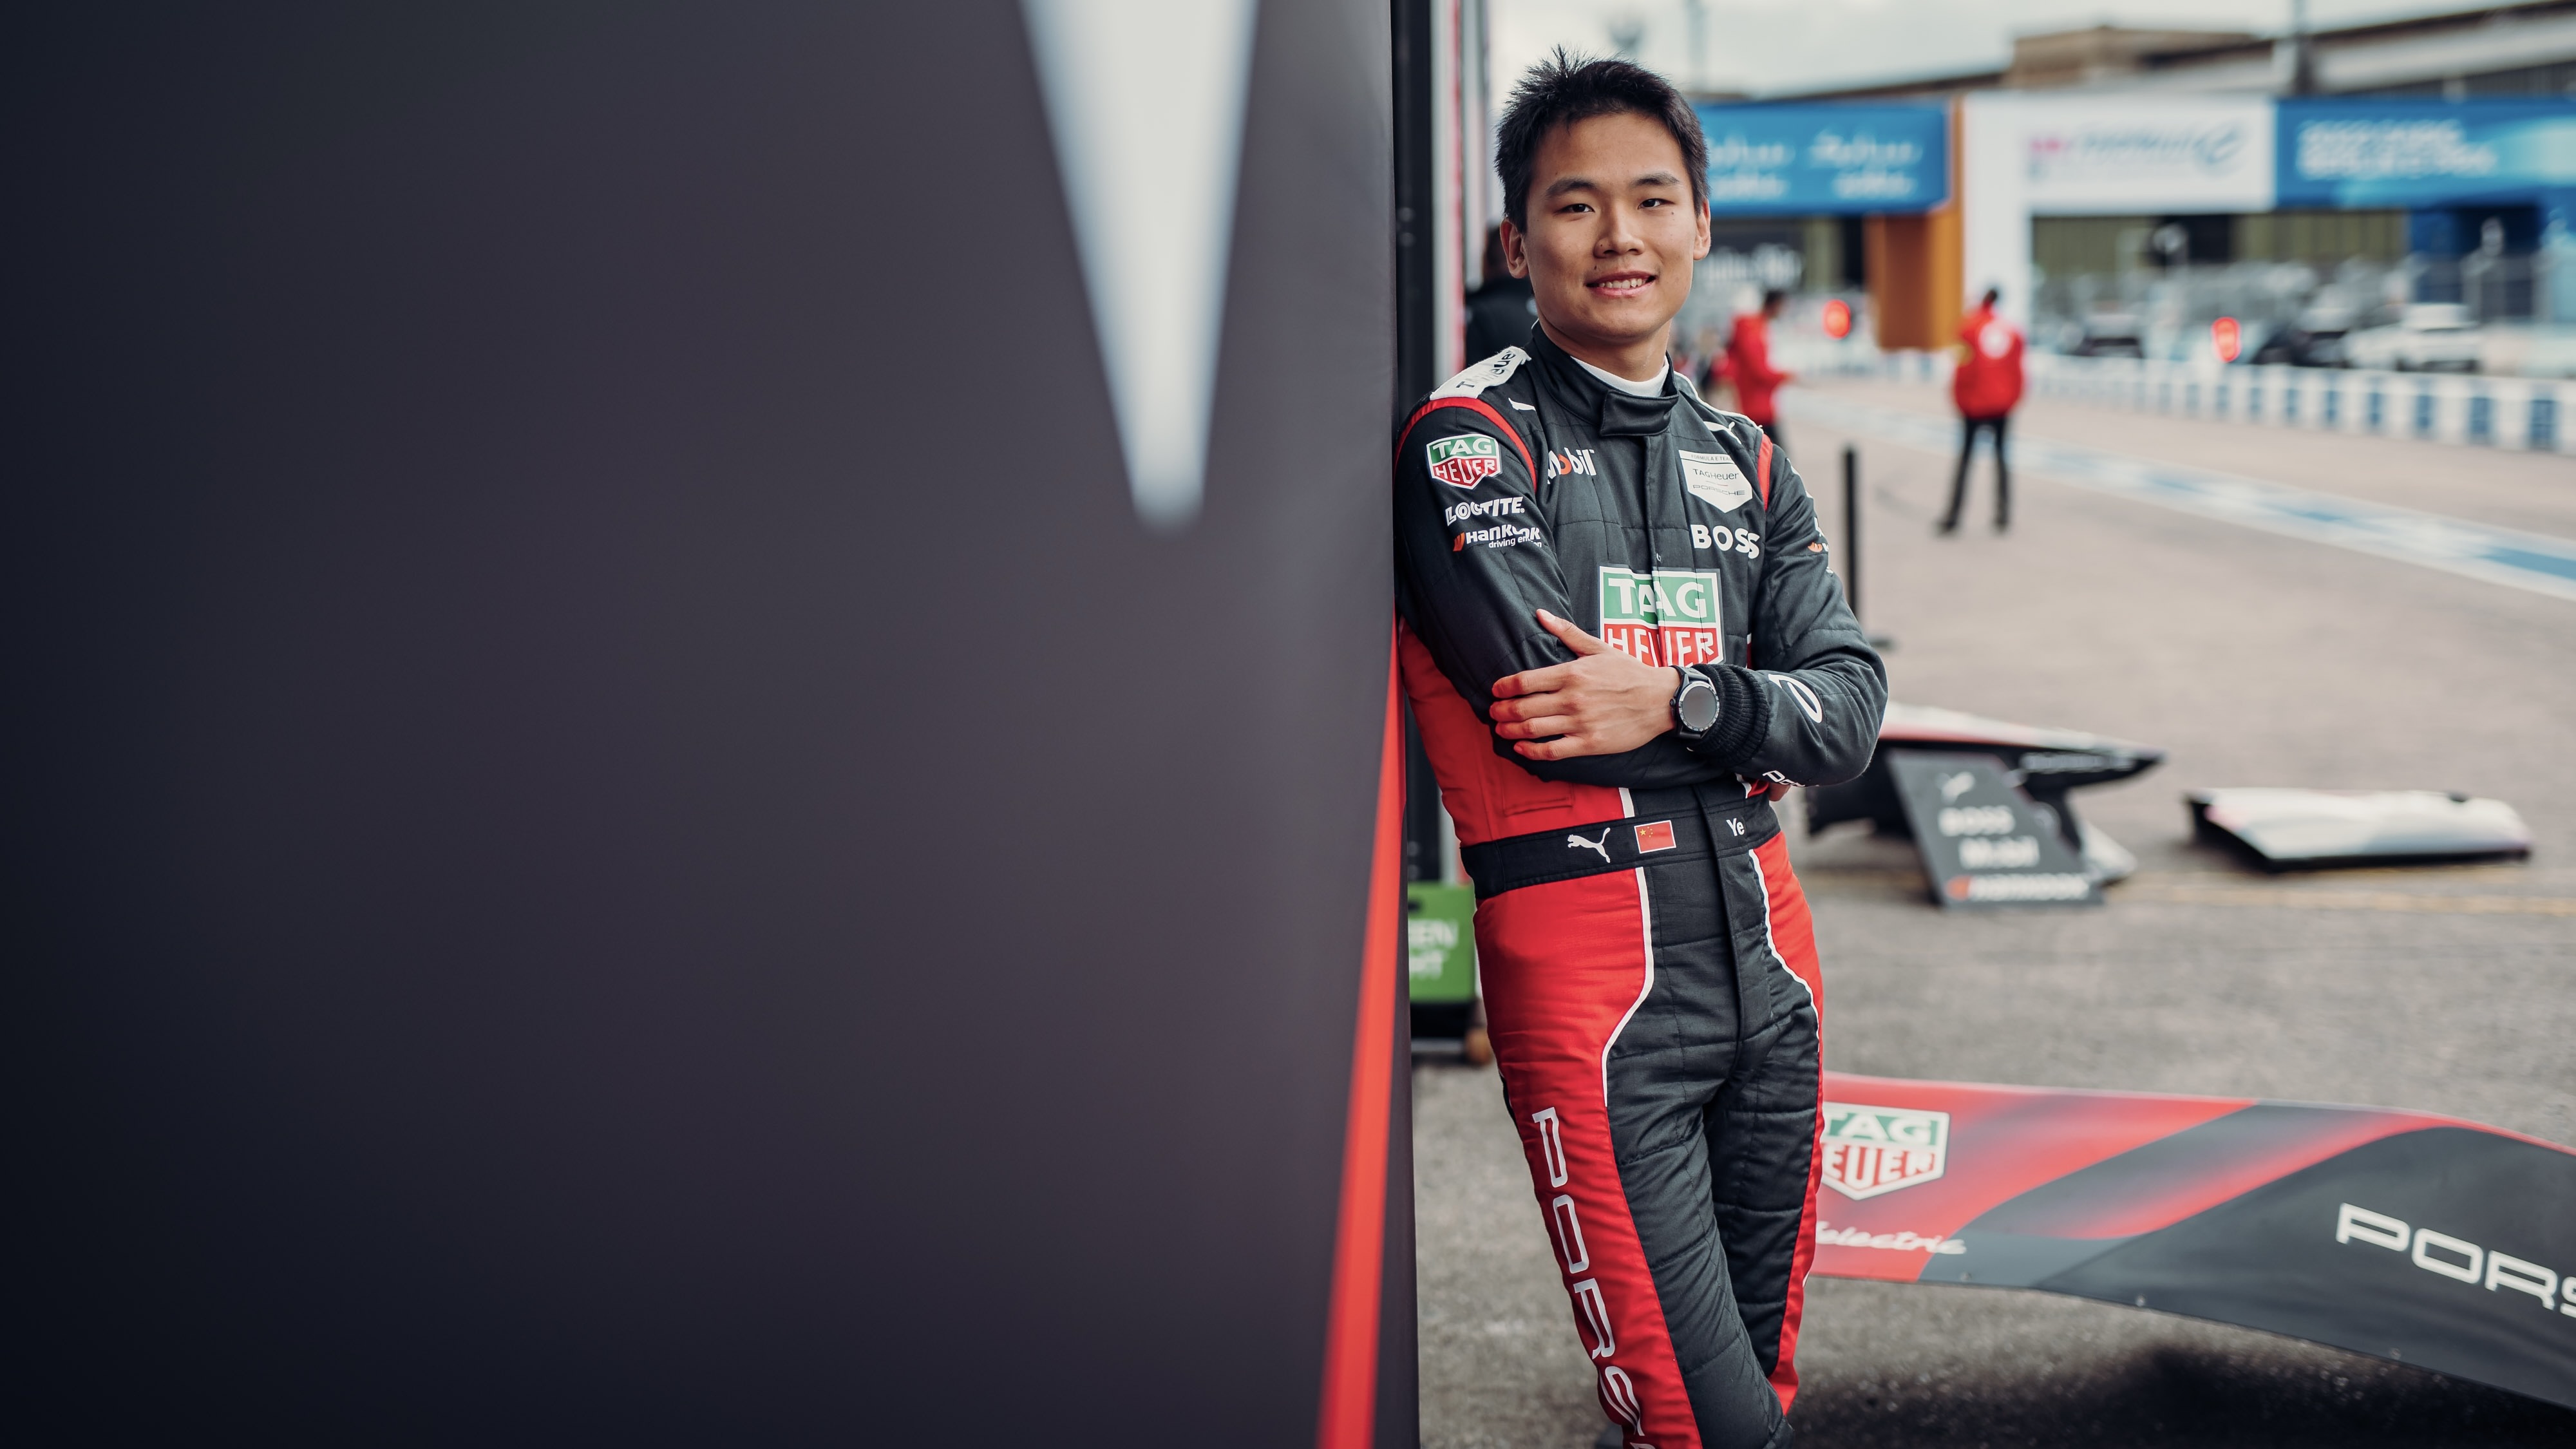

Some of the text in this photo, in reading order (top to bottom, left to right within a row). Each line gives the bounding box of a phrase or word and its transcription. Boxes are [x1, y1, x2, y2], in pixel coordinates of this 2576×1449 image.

[1432, 438, 1492, 459] TAG
[1435, 459, 1497, 484] HEUER
[1548, 447, 1596, 483] Mobil
[1692, 484, 1746, 496] PORSCHE
[1488, 538, 1516, 549] driving
[1690, 524, 1761, 560] BOSS
[1608, 578, 1707, 618] TAG
[1726, 817, 1745, 837] Ye
[2335, 1202, 2576, 1318] POR
[1532, 1106, 1656, 1449] PORS
